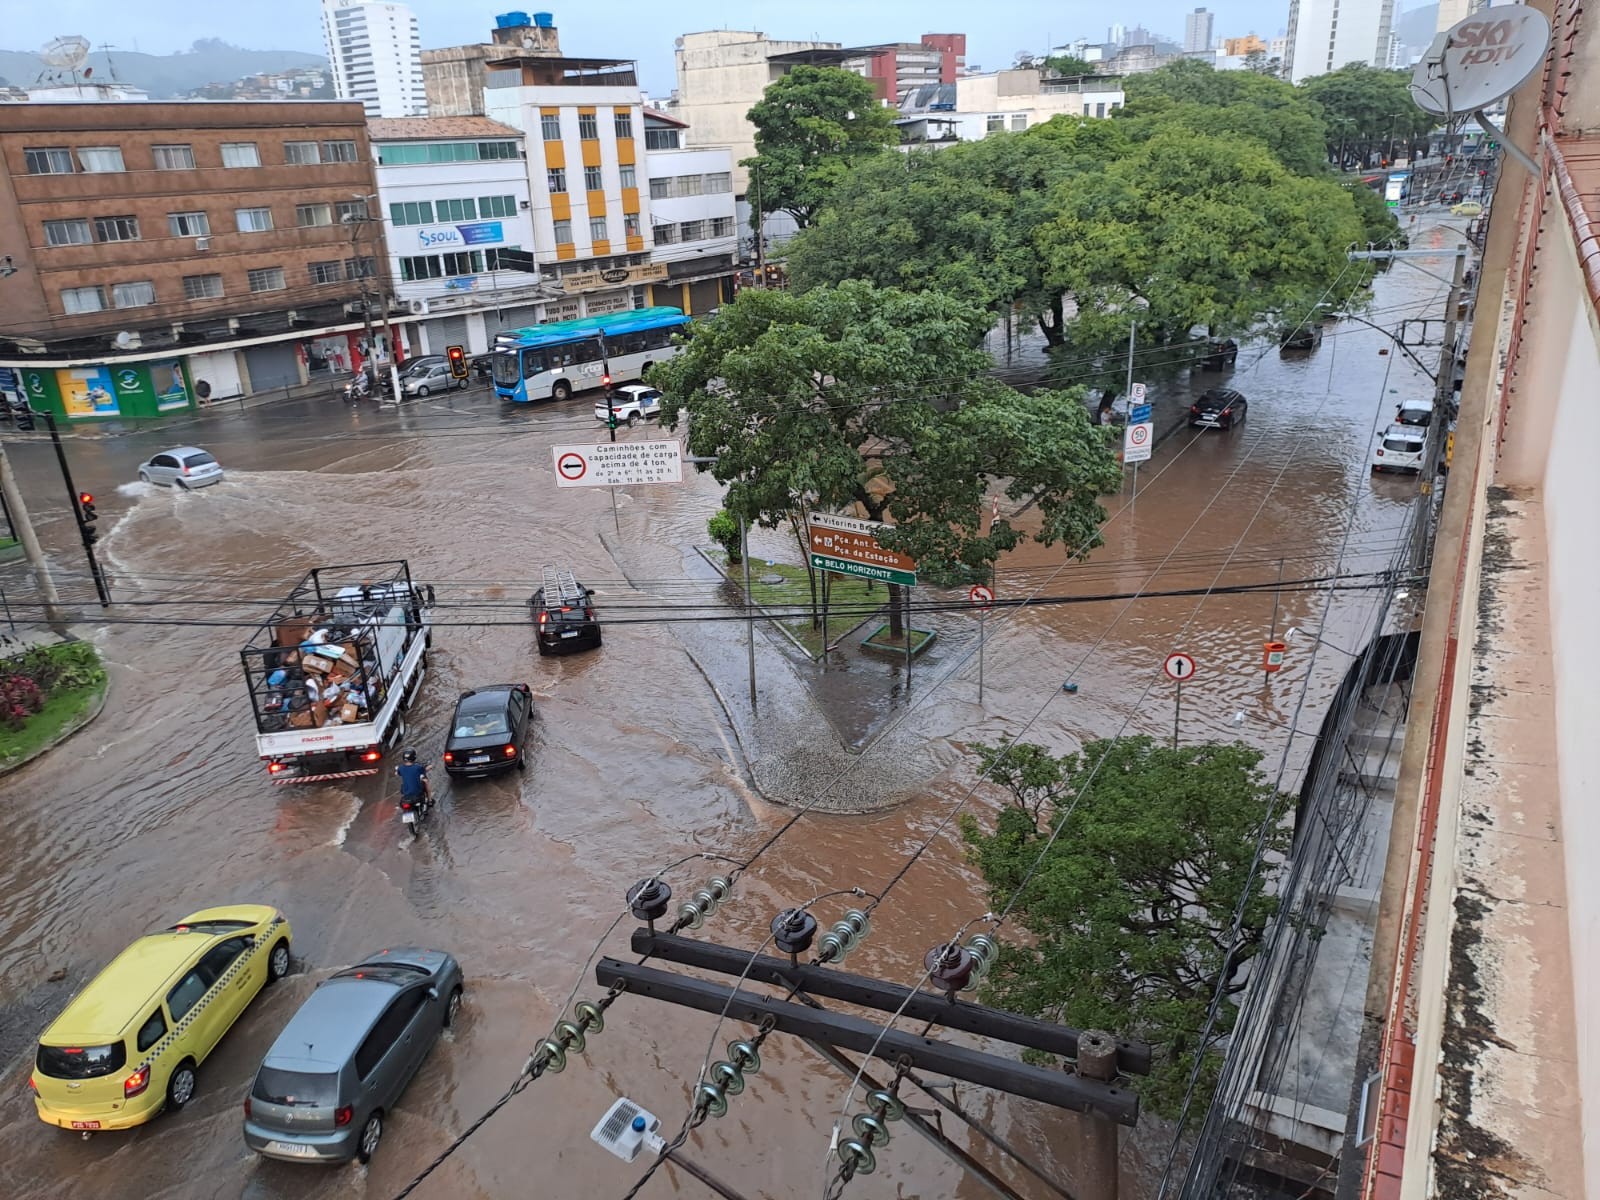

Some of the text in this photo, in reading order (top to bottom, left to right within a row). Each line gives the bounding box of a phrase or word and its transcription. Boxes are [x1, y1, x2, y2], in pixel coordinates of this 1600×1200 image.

[1460, 43, 1525, 64] HDTV
[430, 230, 458, 242] SOUL
[546, 304, 578, 315] TUDO PARA
[1136, 386, 1142, 394] E
[1134, 430, 1144, 439] 50
[596, 444, 646, 453] Caminhões
[588, 452, 638, 462] capacidade
[654, 451, 678, 460] carga
[824, 516, 857, 529] Vitorino
[834, 534, 850, 544] Pça.
[834, 546, 899, 564] Pça. da Estação
[824, 560, 892, 578] BELO HORIZONTE
[302, 735, 334, 743] FACCHINI
